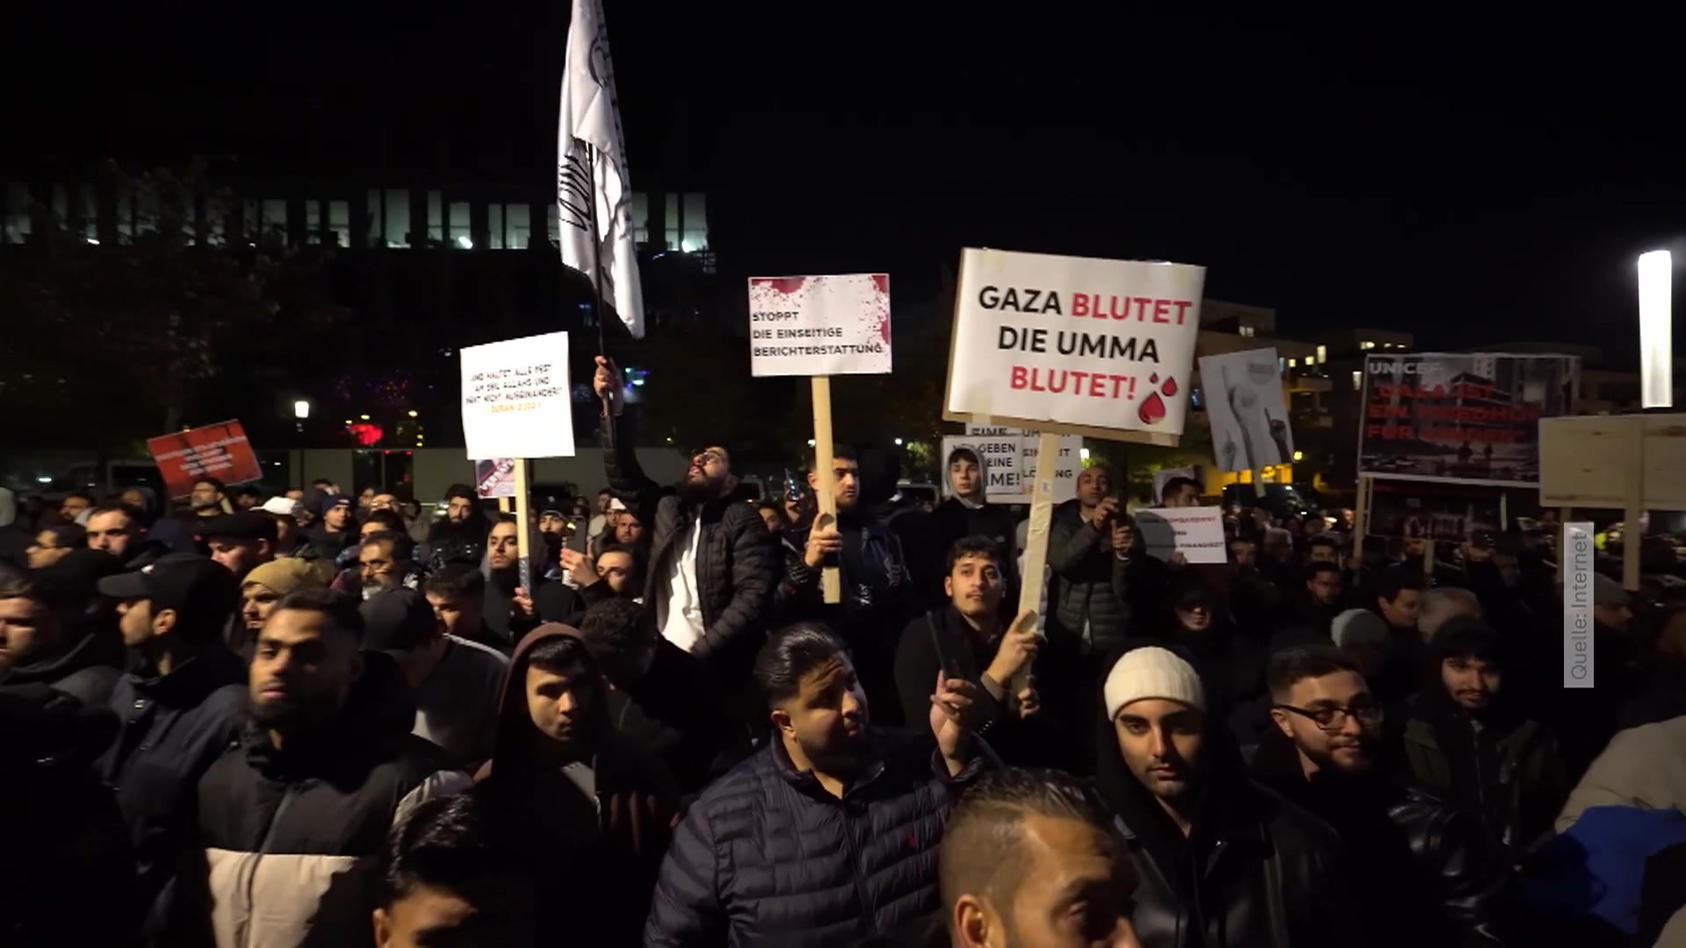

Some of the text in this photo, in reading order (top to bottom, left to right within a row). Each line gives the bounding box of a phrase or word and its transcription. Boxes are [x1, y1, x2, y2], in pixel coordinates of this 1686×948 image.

[979, 285, 1192, 324] GAZA BLUTET
[752, 312, 799, 321] STOPPT
[753, 328, 843, 339] DIE EINSEITIGE
[998, 326, 1160, 363] DIE UMMA
[754, 344, 882, 357] BERICHTERSTATTUNG
[1010, 366, 1136, 400] BLUTET!
